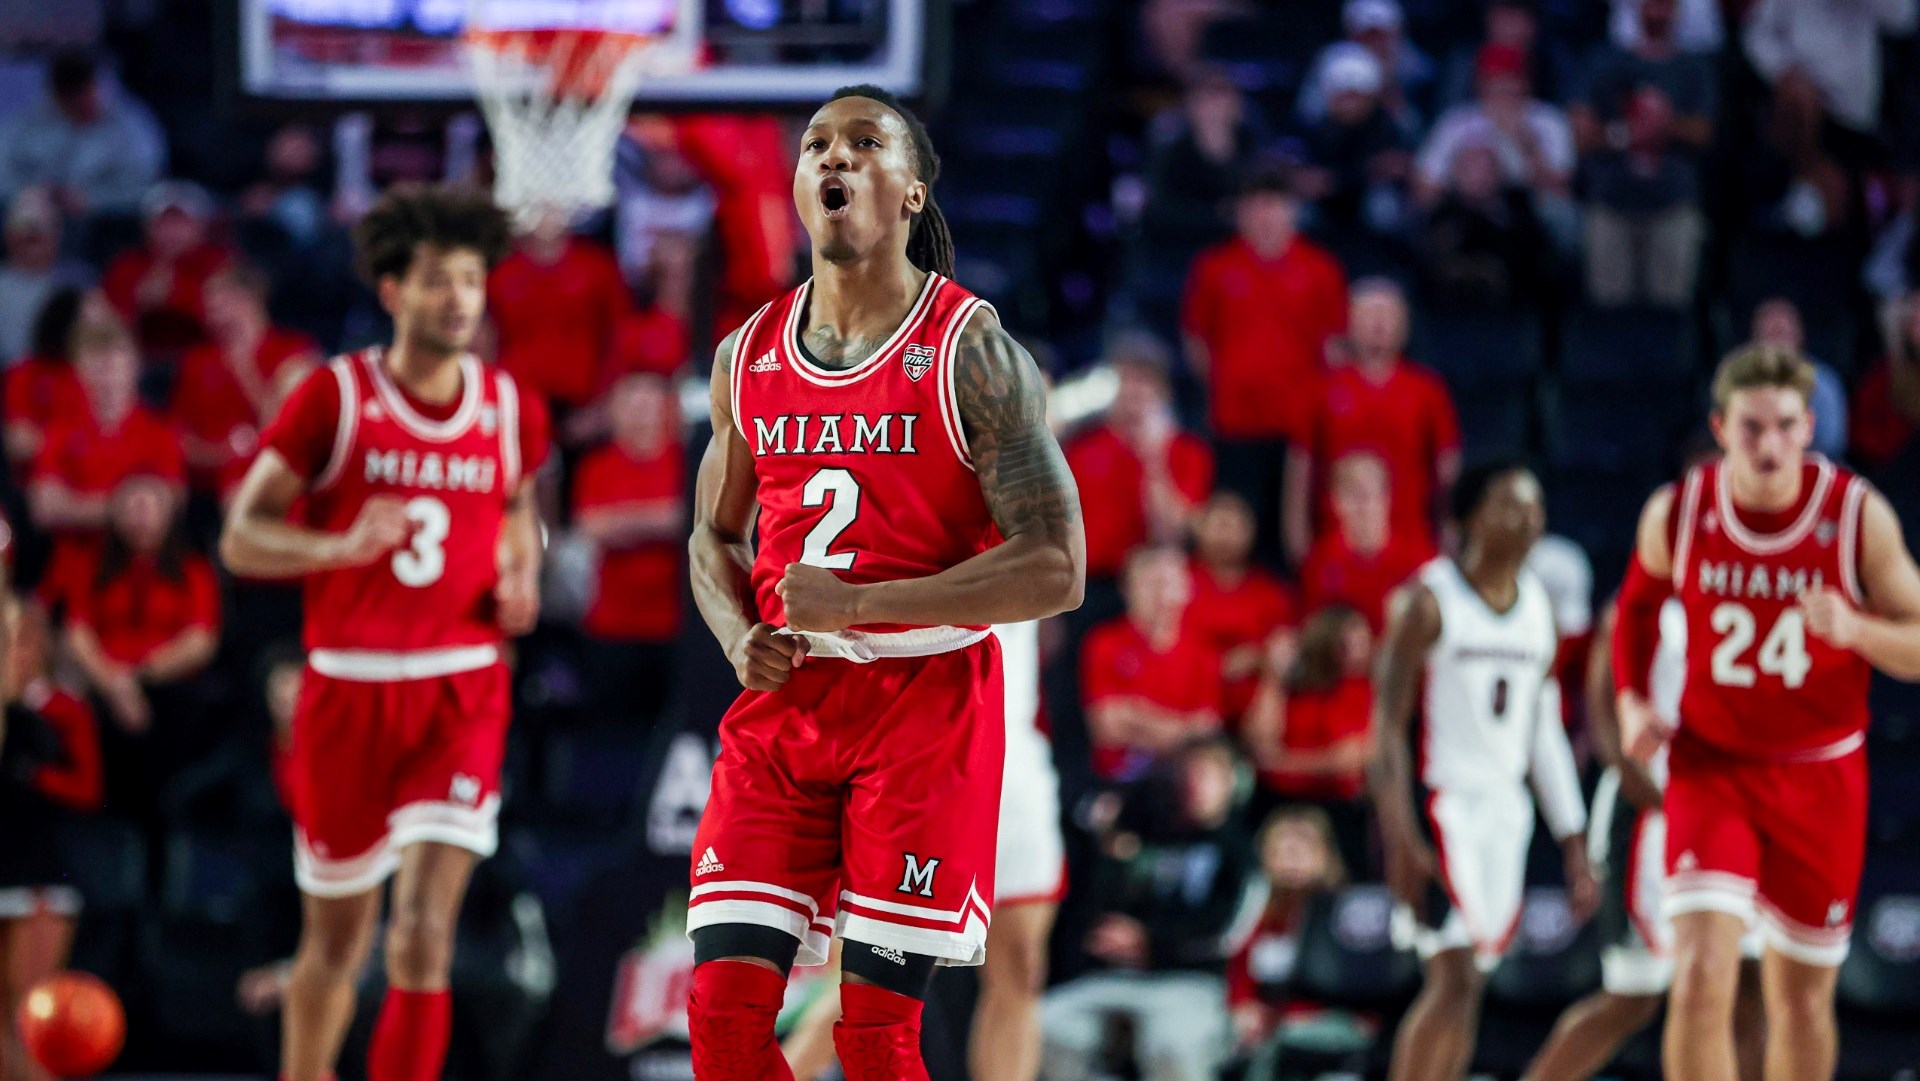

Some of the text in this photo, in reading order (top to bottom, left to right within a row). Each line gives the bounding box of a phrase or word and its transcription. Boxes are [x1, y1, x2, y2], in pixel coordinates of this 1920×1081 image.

[749, 362, 782, 373] adidas
[905, 354, 933, 366] MAC
[753, 413, 919, 457] MIAMI
[363, 449, 496, 494] MIAMI
[802, 468, 861, 570] 2
[390, 495, 451, 588] 3
[1698, 559, 1824, 601] MIAMI
[1711, 602, 1813, 689] 24
[695, 862, 725, 877] adidas
[898, 852, 942, 898] M
[871, 945, 906, 966] adidas
